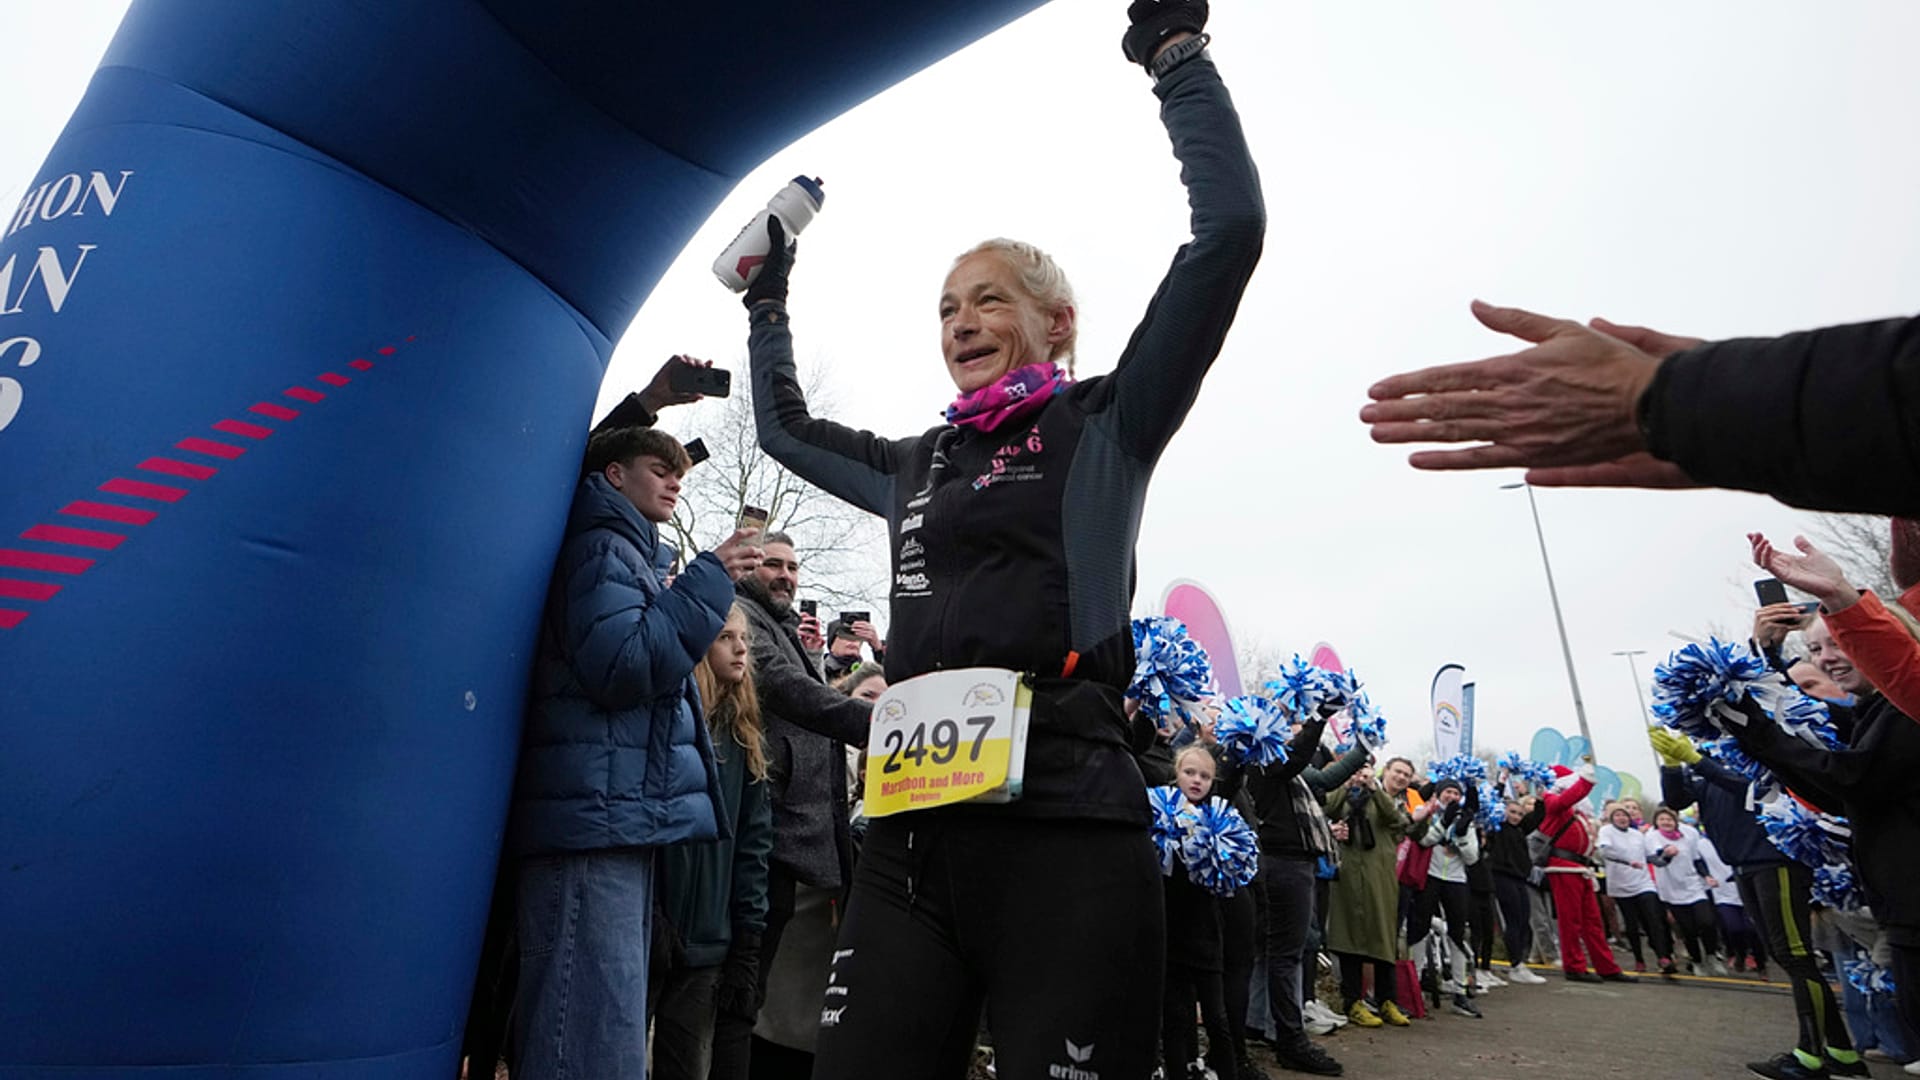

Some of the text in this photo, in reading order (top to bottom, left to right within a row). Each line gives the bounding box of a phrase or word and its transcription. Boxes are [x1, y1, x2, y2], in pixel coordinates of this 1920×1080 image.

[1026, 435, 1044, 453] 6
[882, 715, 996, 774] 2497
[881, 770, 985, 796] Marathon and More
[1049, 1063, 1099, 1080] erima
